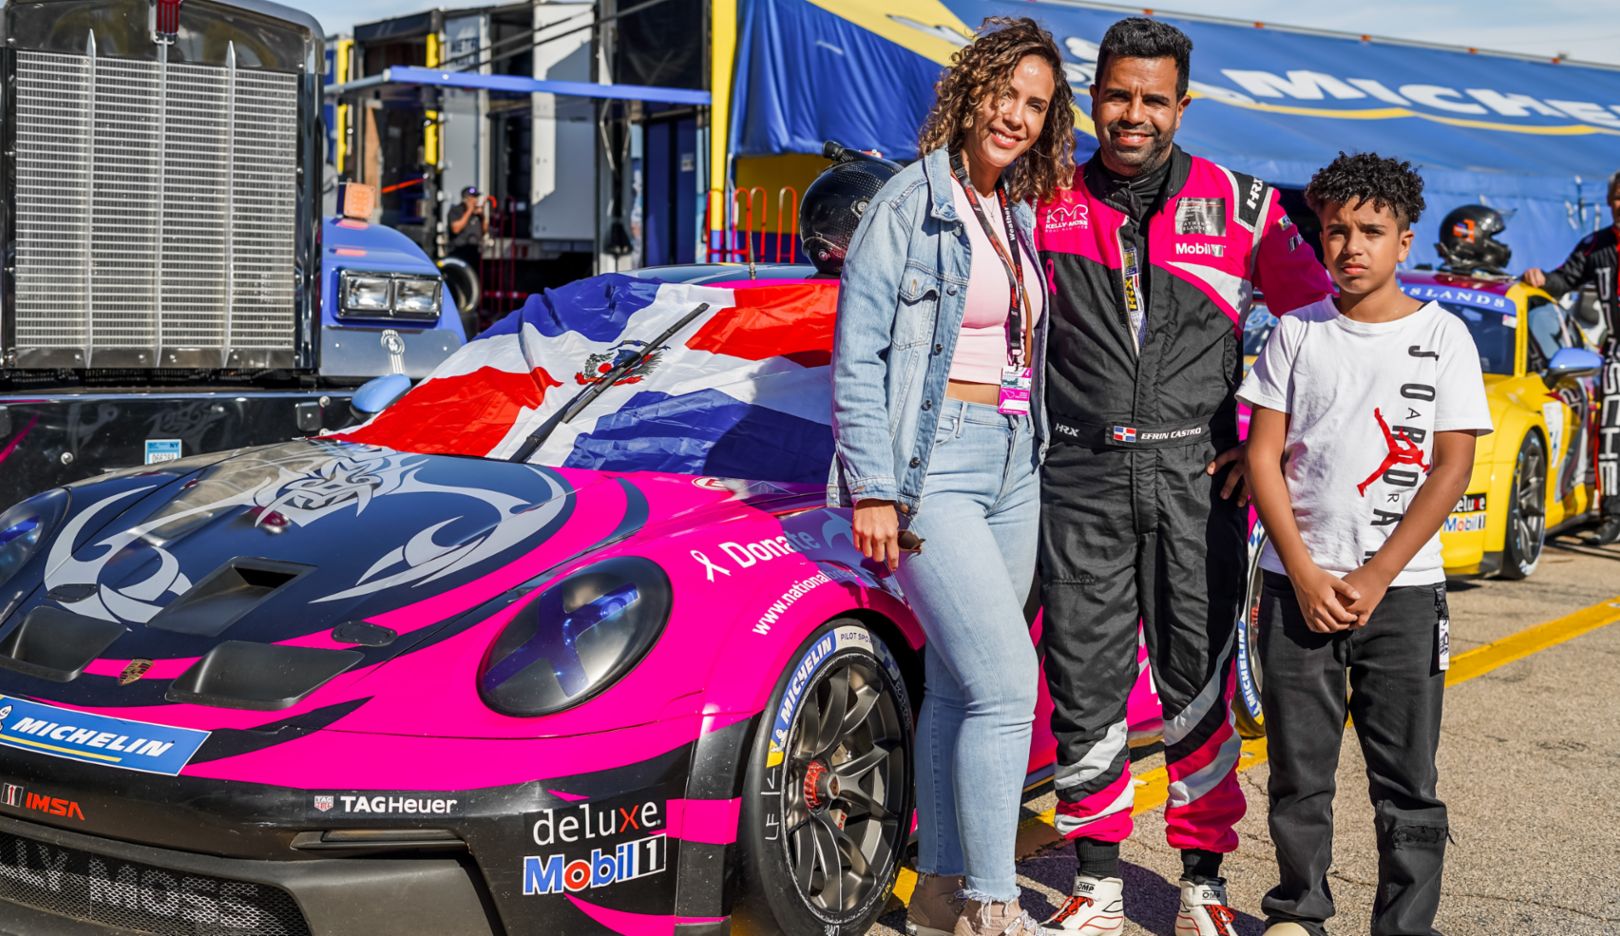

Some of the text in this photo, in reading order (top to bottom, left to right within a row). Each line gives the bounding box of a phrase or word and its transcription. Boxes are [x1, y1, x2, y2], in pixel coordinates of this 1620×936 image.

[1221, 69, 1620, 128] MICHE
[1055, 422, 1080, 438] HRX
[1140, 427, 1202, 441] EFRIN CASTRO
[1453, 495, 1486, 512] eluxe
[718, 530, 822, 569] Donate
[840, 632, 857, 641] PILOT
[780, 636, 833, 725] MICHELIN
[1238, 629, 1257, 706] MICHELIN
[10, 716, 174, 758] MICHELIN
[25, 791, 86, 822] IMSA
[532, 800, 660, 846] deluxe
[0, 838, 259, 928] LY MOSS
[523, 842, 635, 896] Mobil
[1077, 884, 1096, 893] OMP
